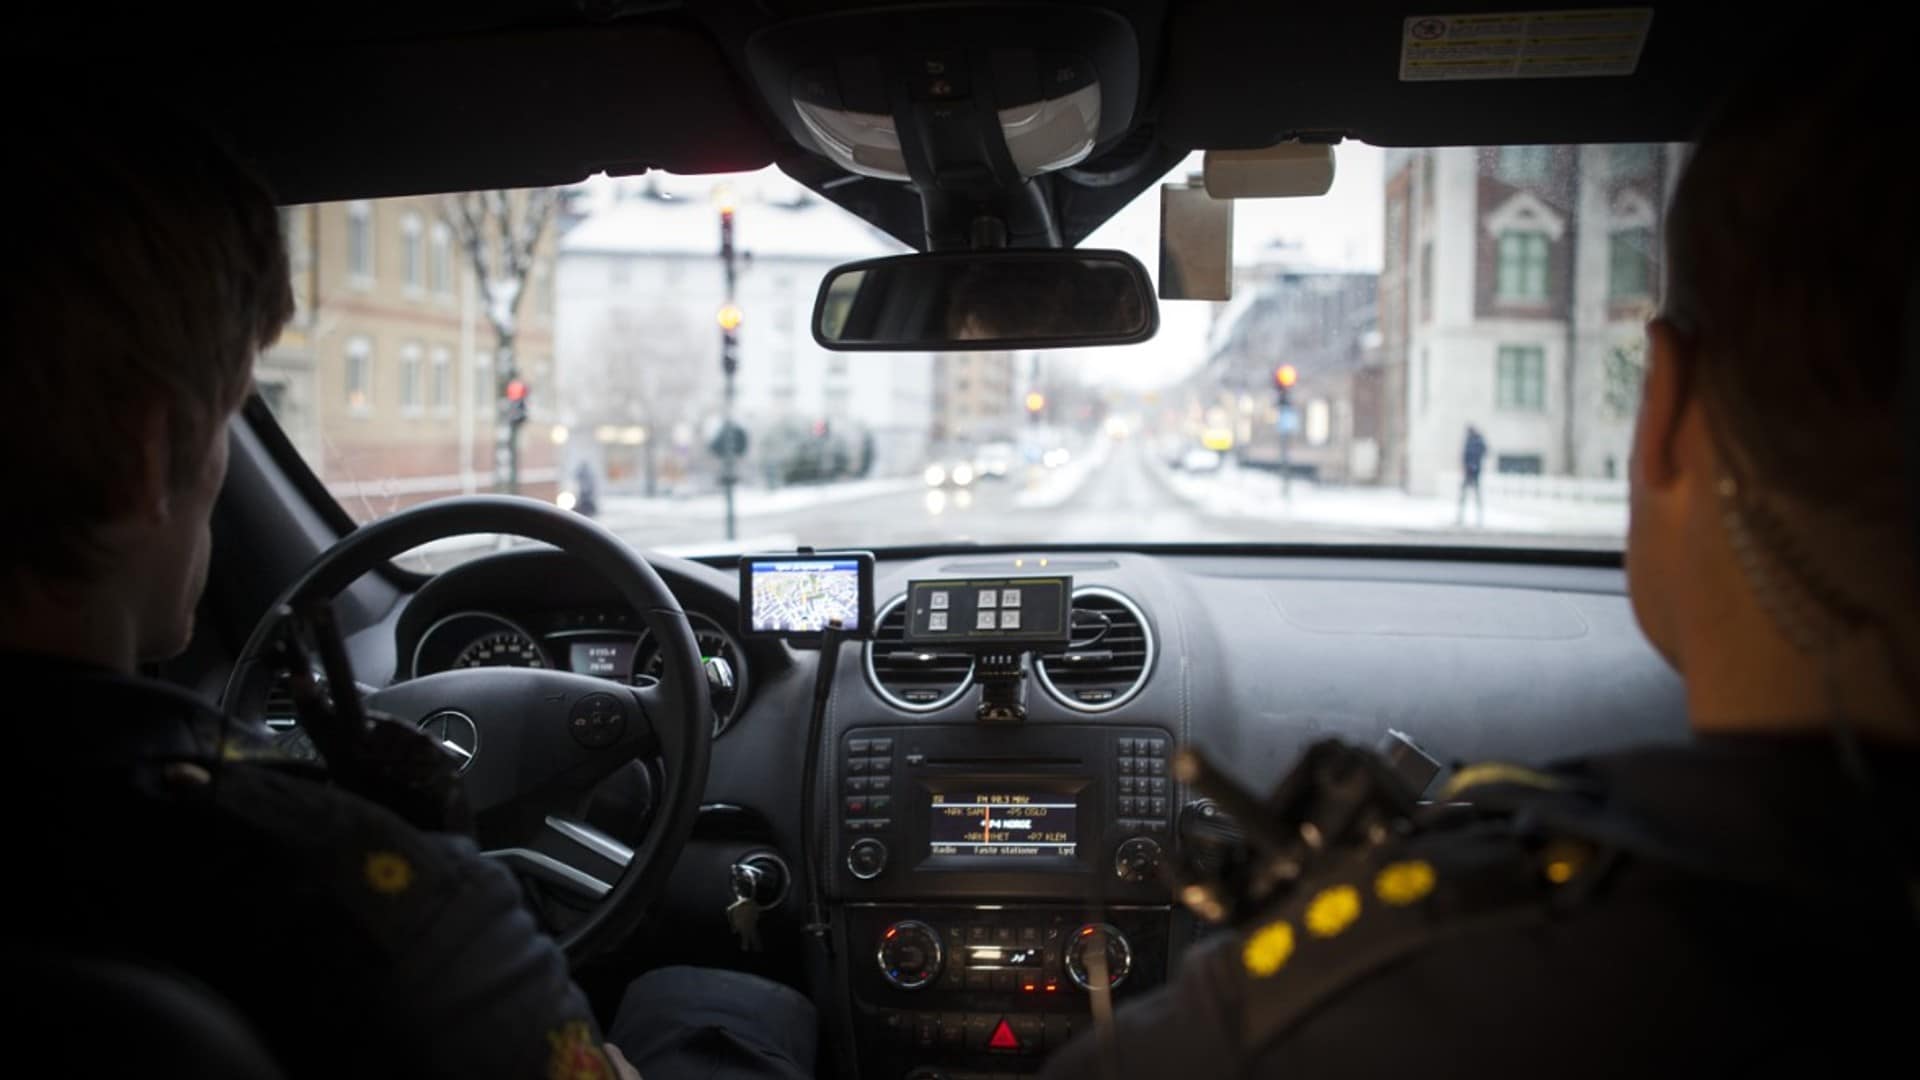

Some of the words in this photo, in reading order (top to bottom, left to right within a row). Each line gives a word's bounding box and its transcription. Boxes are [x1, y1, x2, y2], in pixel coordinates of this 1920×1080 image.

[1024, 807, 1048, 817] OSLO
[1003, 819, 1032, 829] NORGE
[1045, 831, 1067, 841] KLEM
[932, 846, 957, 854] Radio
[1058, 846, 1075, 856] Lyd
